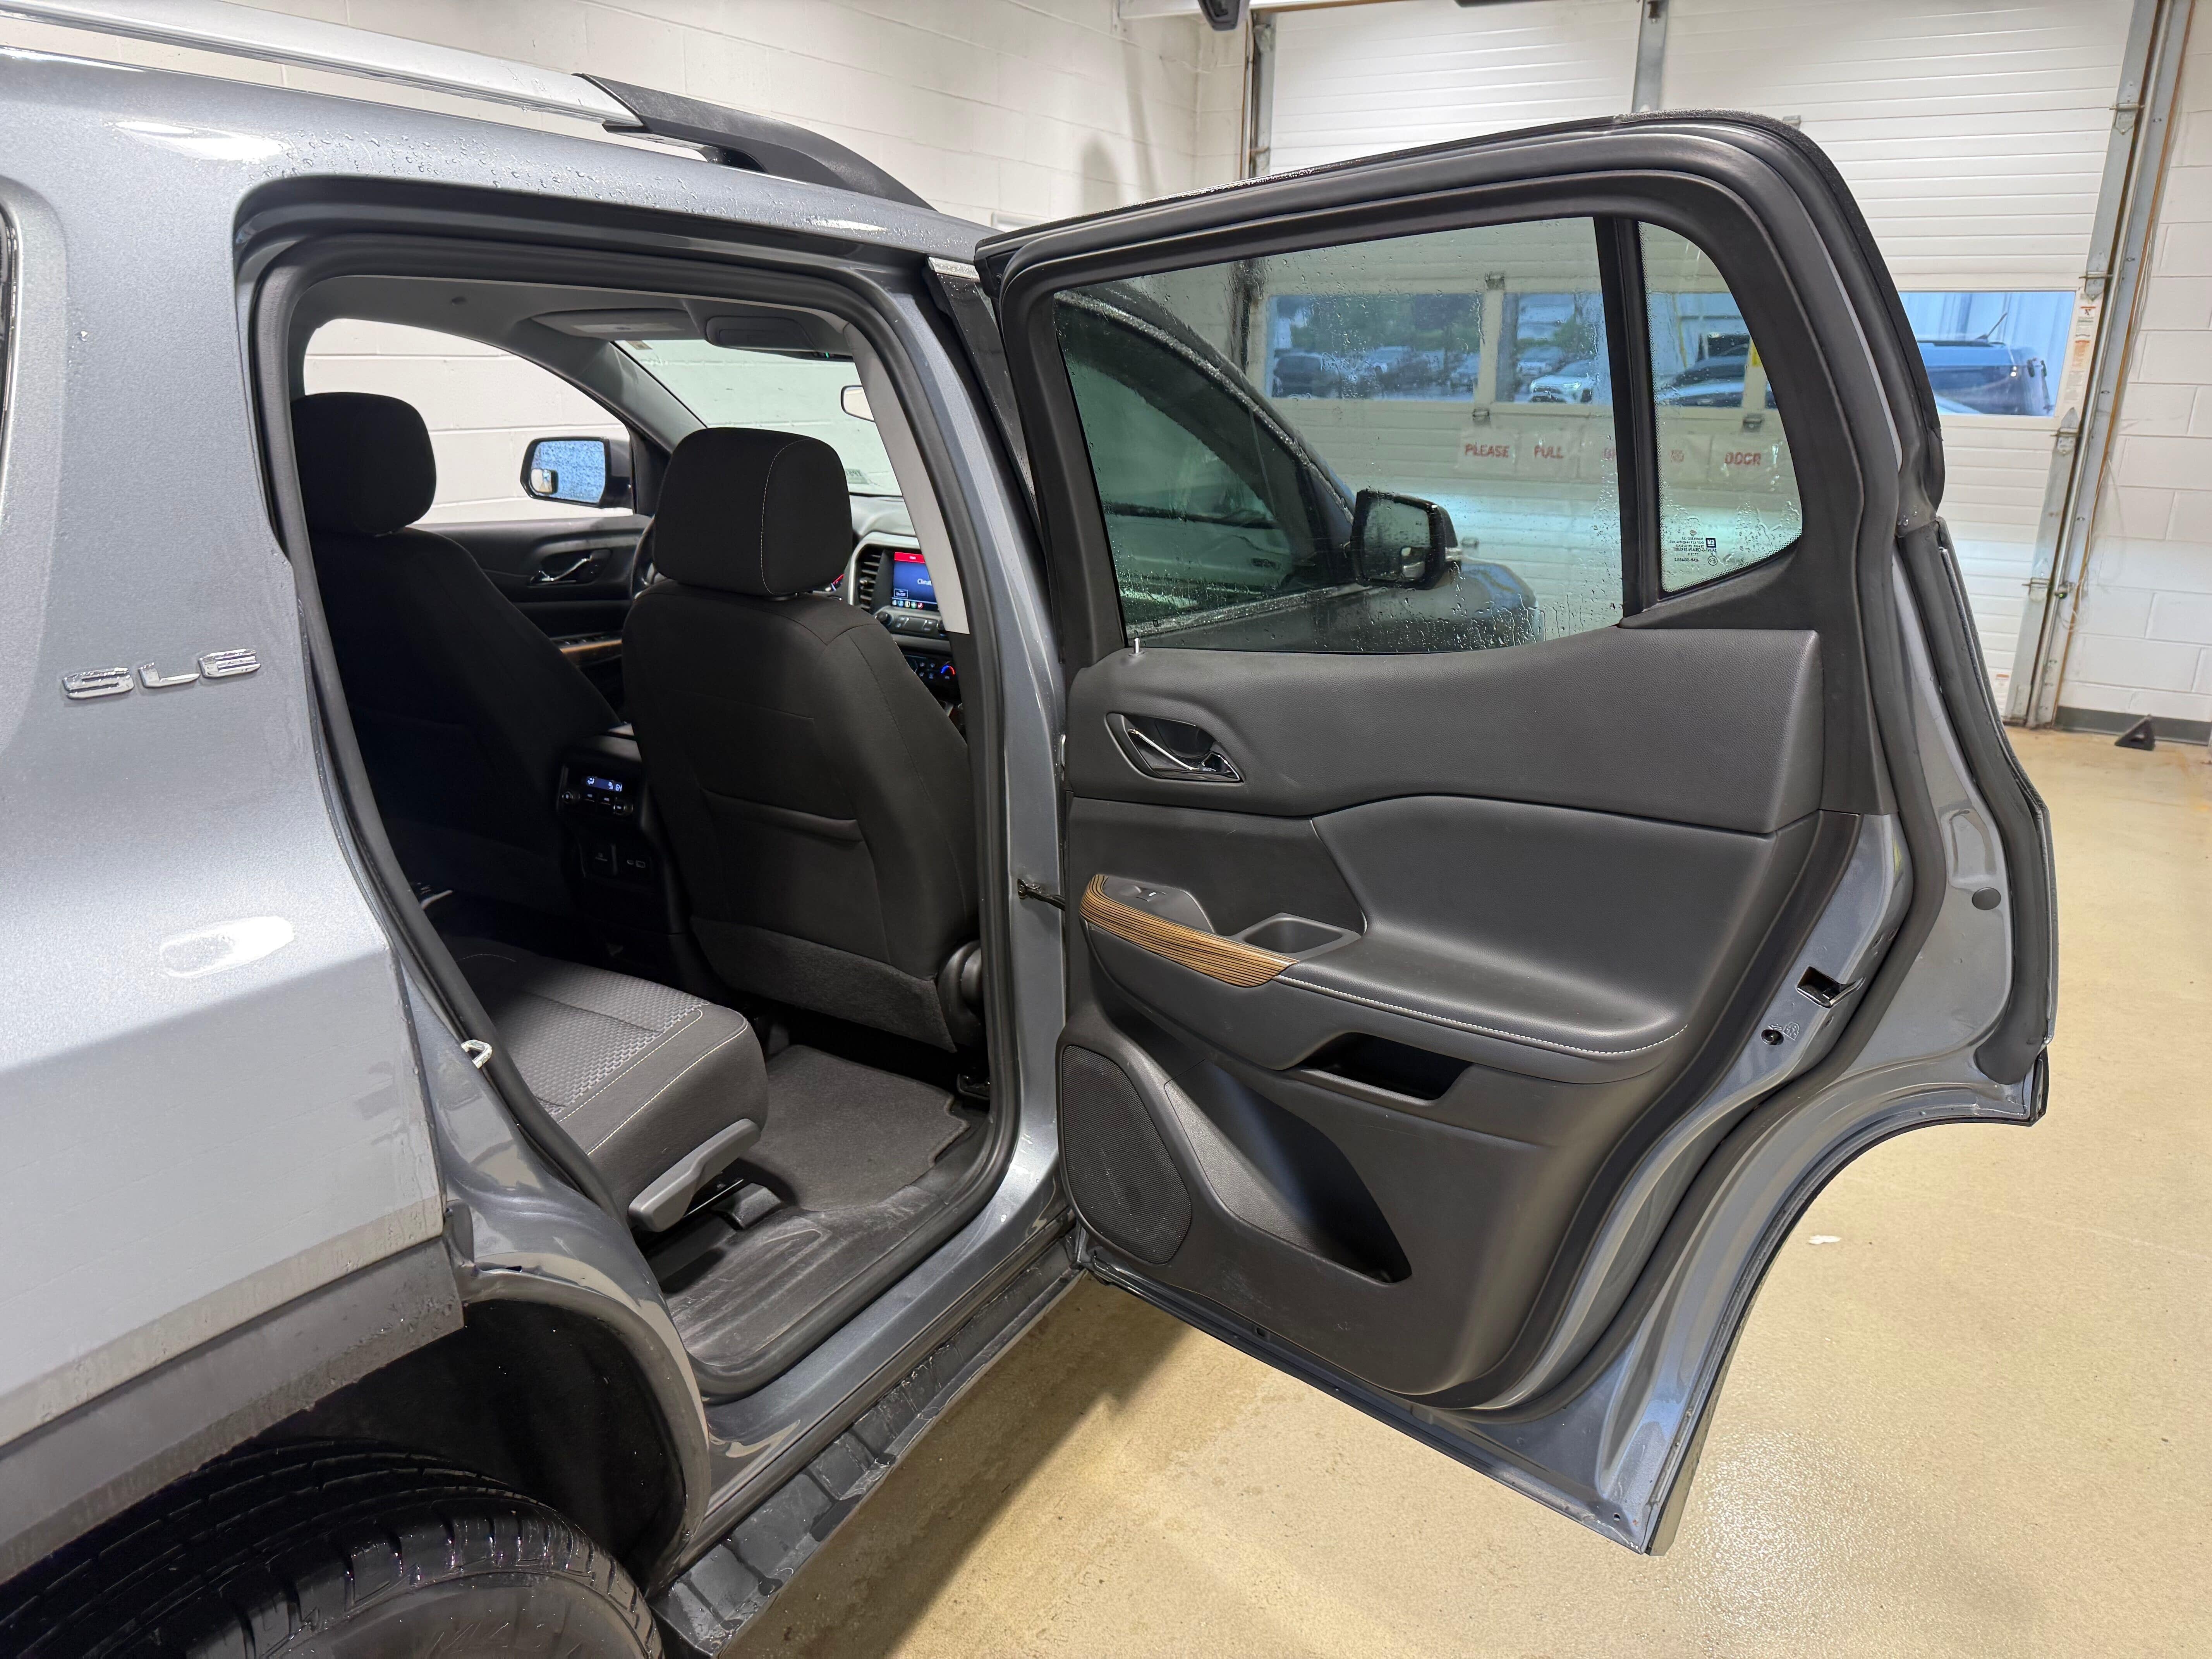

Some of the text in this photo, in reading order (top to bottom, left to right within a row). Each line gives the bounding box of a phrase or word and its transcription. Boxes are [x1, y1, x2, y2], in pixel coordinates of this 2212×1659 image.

[1465, 443, 1509, 458] PLEASE
[1534, 445, 1564, 459] PULL
[1724, 452, 1761, 465] DOOR
[62, 648, 261, 699] SLE
